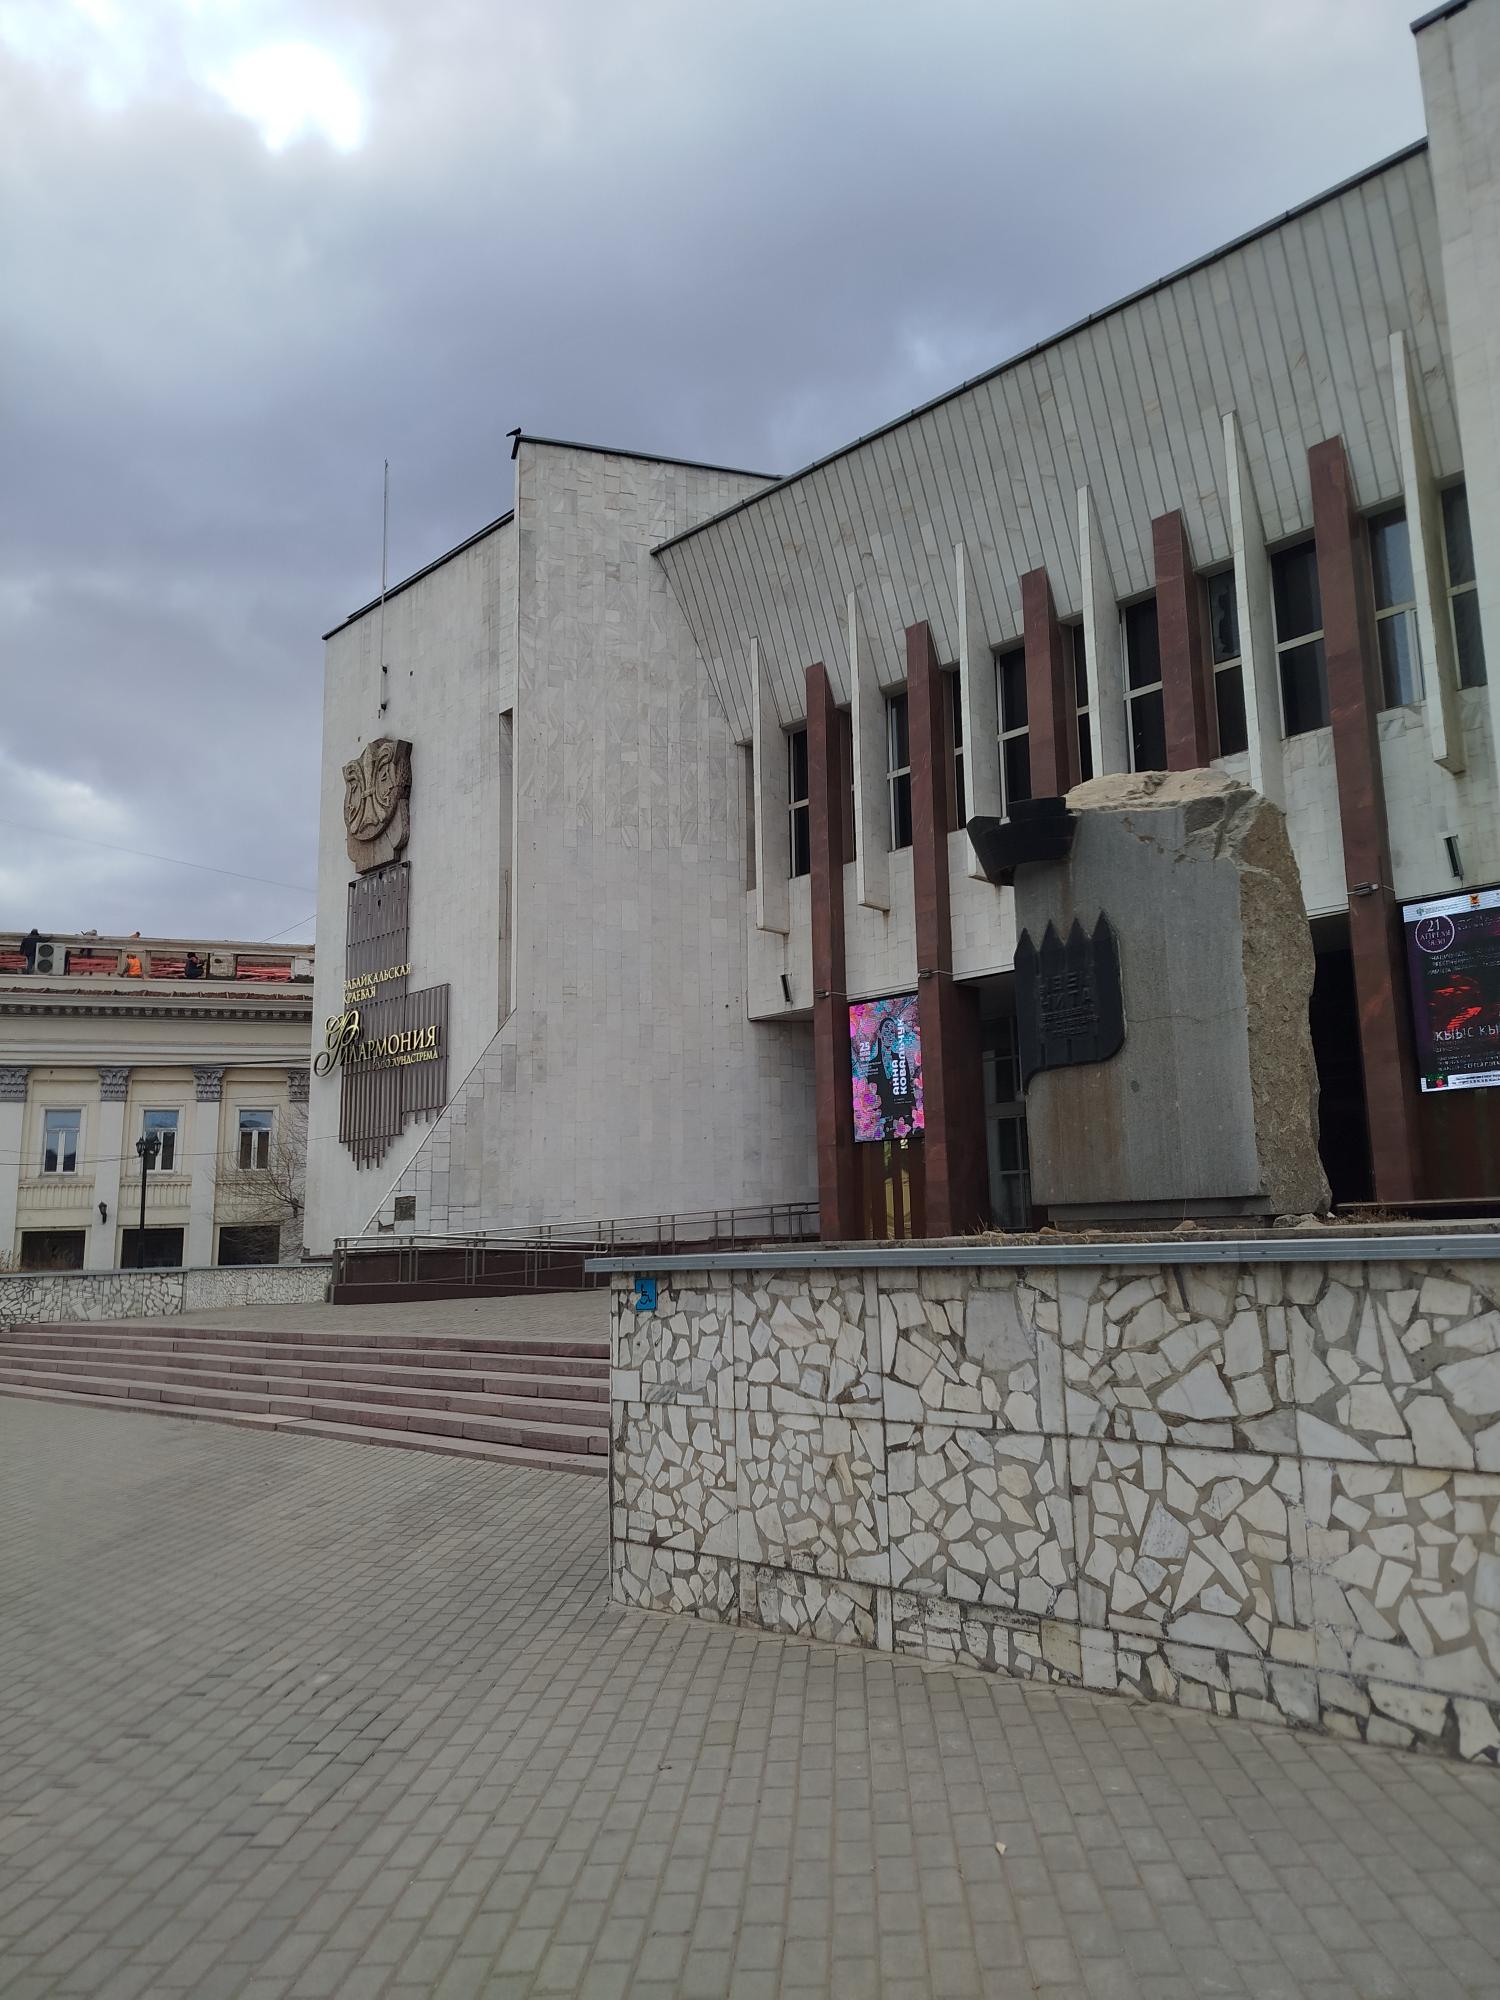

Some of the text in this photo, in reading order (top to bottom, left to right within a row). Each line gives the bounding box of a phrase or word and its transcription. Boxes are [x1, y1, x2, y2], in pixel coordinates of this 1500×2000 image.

[1427, 919, 1440, 932] 21
[343, 962, 412, 991] ЗАБАЙКАЛЬСКАЯ
[343, 986, 377, 1004] КРАЕВАЯ
[314, 1010, 437, 1077] ФИЛАРМОНИЯ
[891, 1060, 900, 1096] АННА
